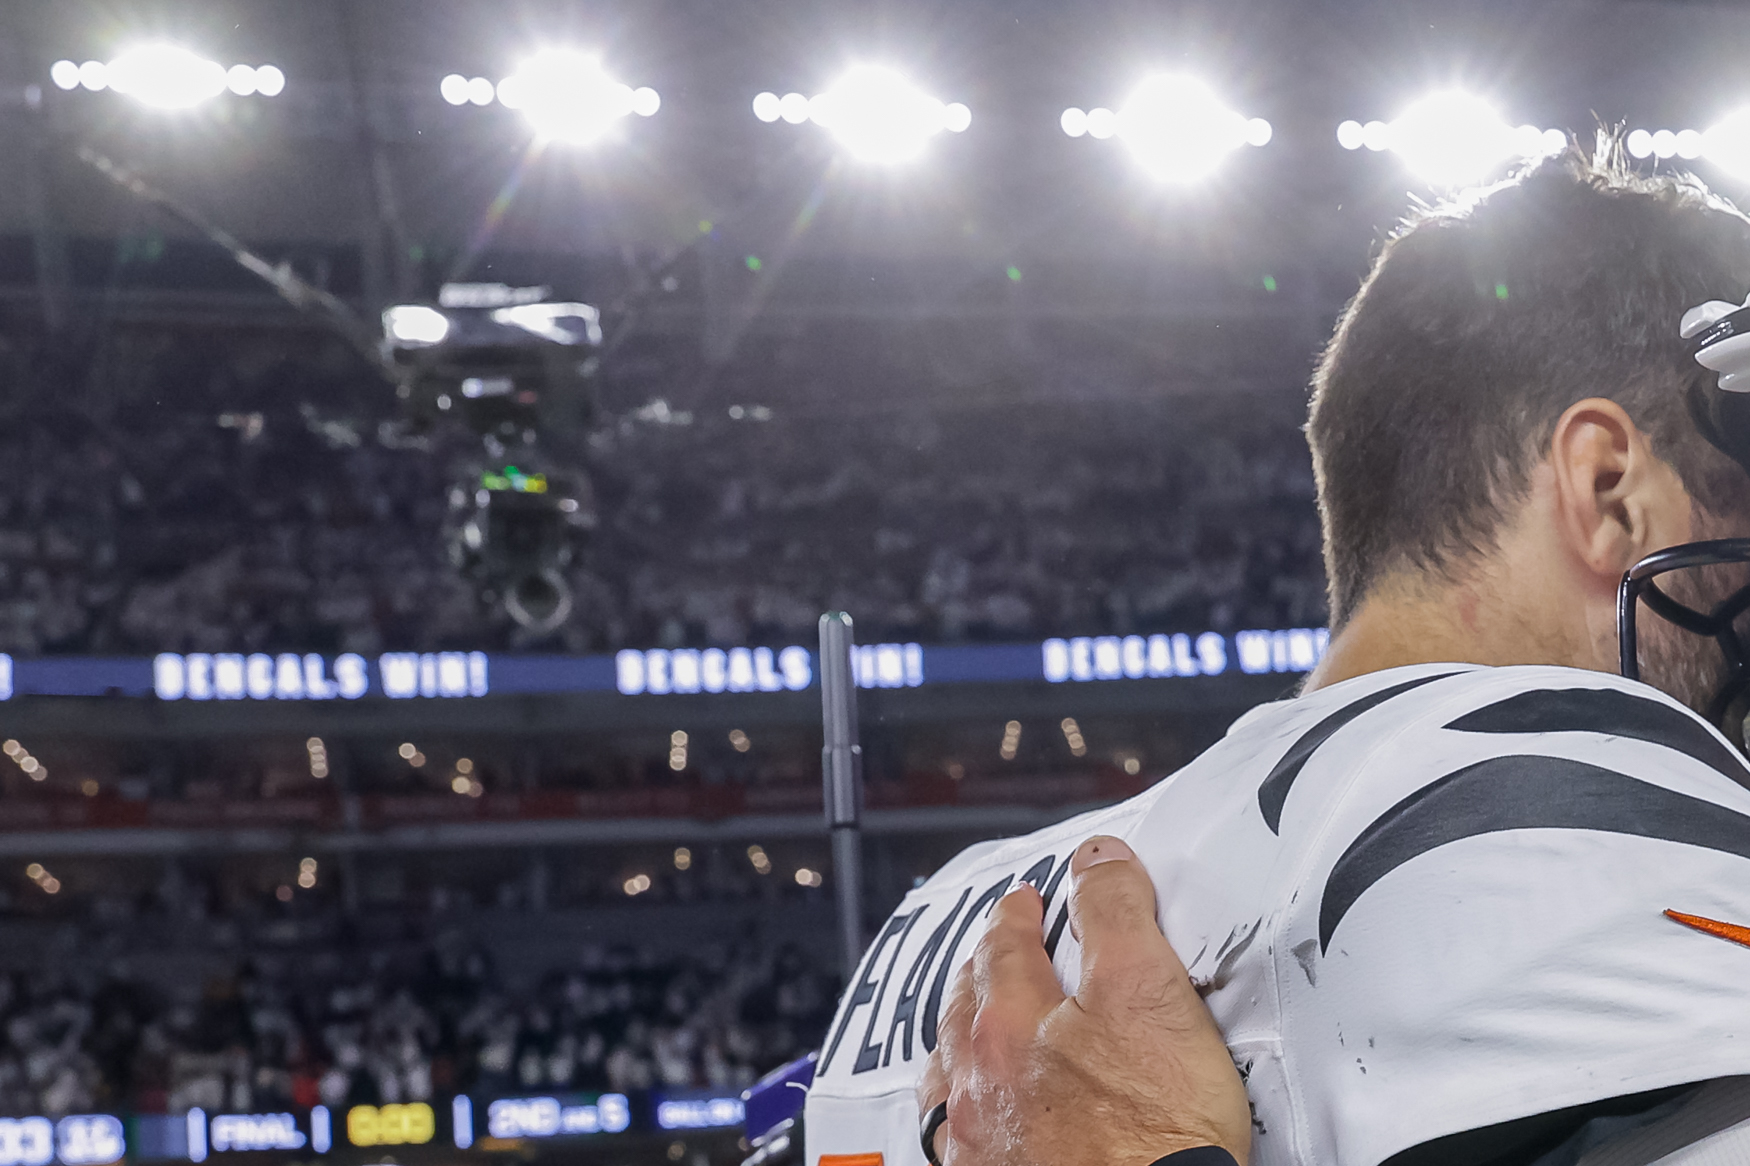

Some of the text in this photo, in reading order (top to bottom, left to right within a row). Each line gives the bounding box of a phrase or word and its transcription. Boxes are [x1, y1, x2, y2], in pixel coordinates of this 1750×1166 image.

[153, 650, 489, 700] BENGALS WIN!
[615, 642, 924, 695] BENGALS IN!
[1042, 632, 1227, 683] BENGALS
[211, 1112, 306, 1152] FINAL
